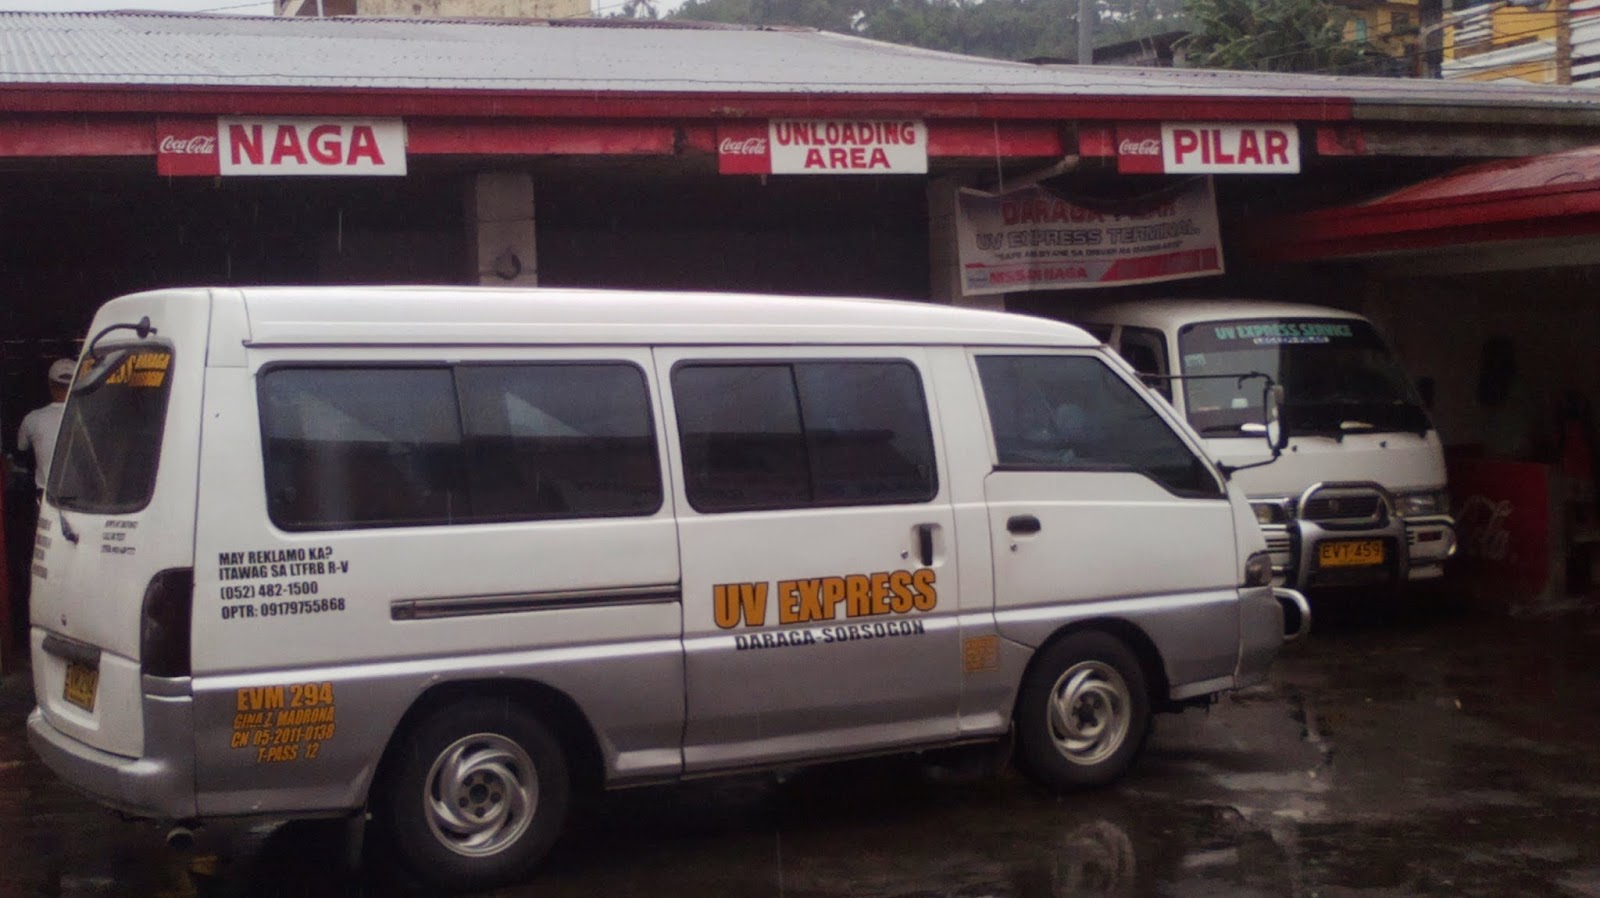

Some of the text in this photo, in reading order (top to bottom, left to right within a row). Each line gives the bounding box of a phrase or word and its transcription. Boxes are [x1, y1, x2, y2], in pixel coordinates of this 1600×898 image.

[775, 121, 916, 146] UNLOADING
[229, 124, 385, 165] NAGA
[1173, 129, 1289, 165] PILAR
[804, 148, 891, 169] AREA
[1007, 228, 1102, 248] EXPRESS
[1107, 218, 1201, 243] TERMINAL
[1215, 324, 1353, 340] UV EXPRESS SERVICE
[219, 546, 333, 565] MAY REKLAMO KA?
[219, 560, 349, 581] ITAWAG SA LTFRB R-V
[220, 581, 318, 600] (052) 482-1500
[713, 568, 937, 628] UV EXPRESS
[221, 598, 346, 619] OPTR: 09179755868
[734, 620, 926, 651] DARAGA-SORSOGON
[237, 681, 334, 711] EVM 294
[233, 711, 263, 729] GINA
[231, 730, 249, 748] CN
[258, 742, 320, 763] T-PASS 12
